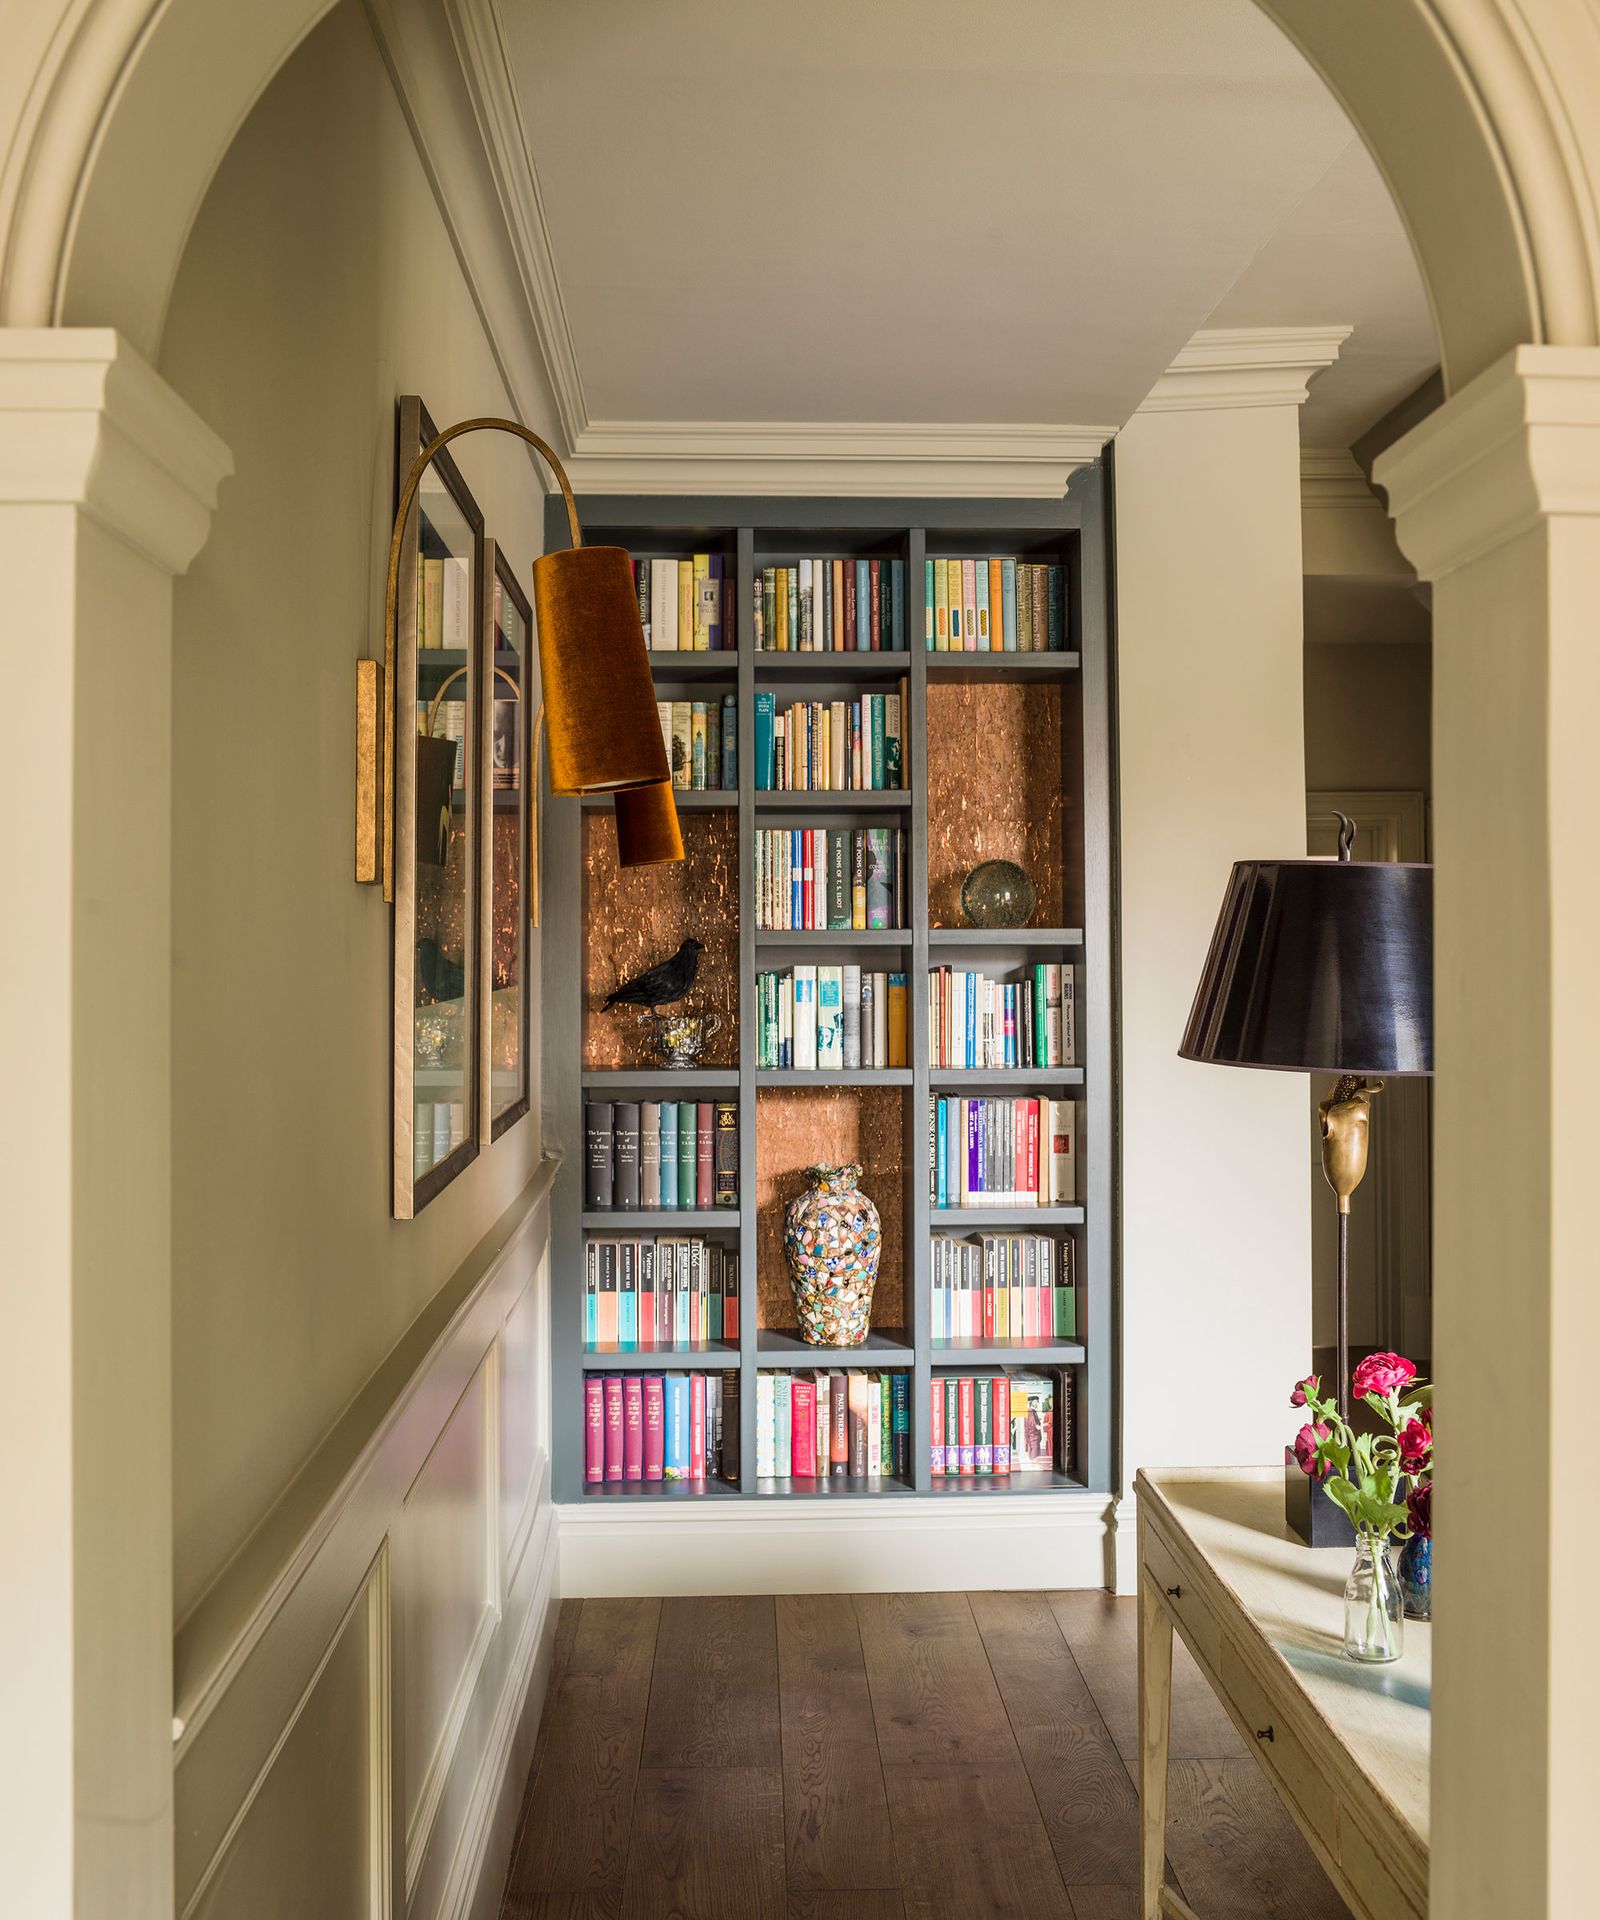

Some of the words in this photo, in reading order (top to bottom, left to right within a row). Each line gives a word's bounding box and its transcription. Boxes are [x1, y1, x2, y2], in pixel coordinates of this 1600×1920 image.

[640, 580, 648, 594] TED
[640, 594, 648, 622] HUGHES
[874, 697, 882, 716] Sylvia
[874, 734, 882, 760] Collected
